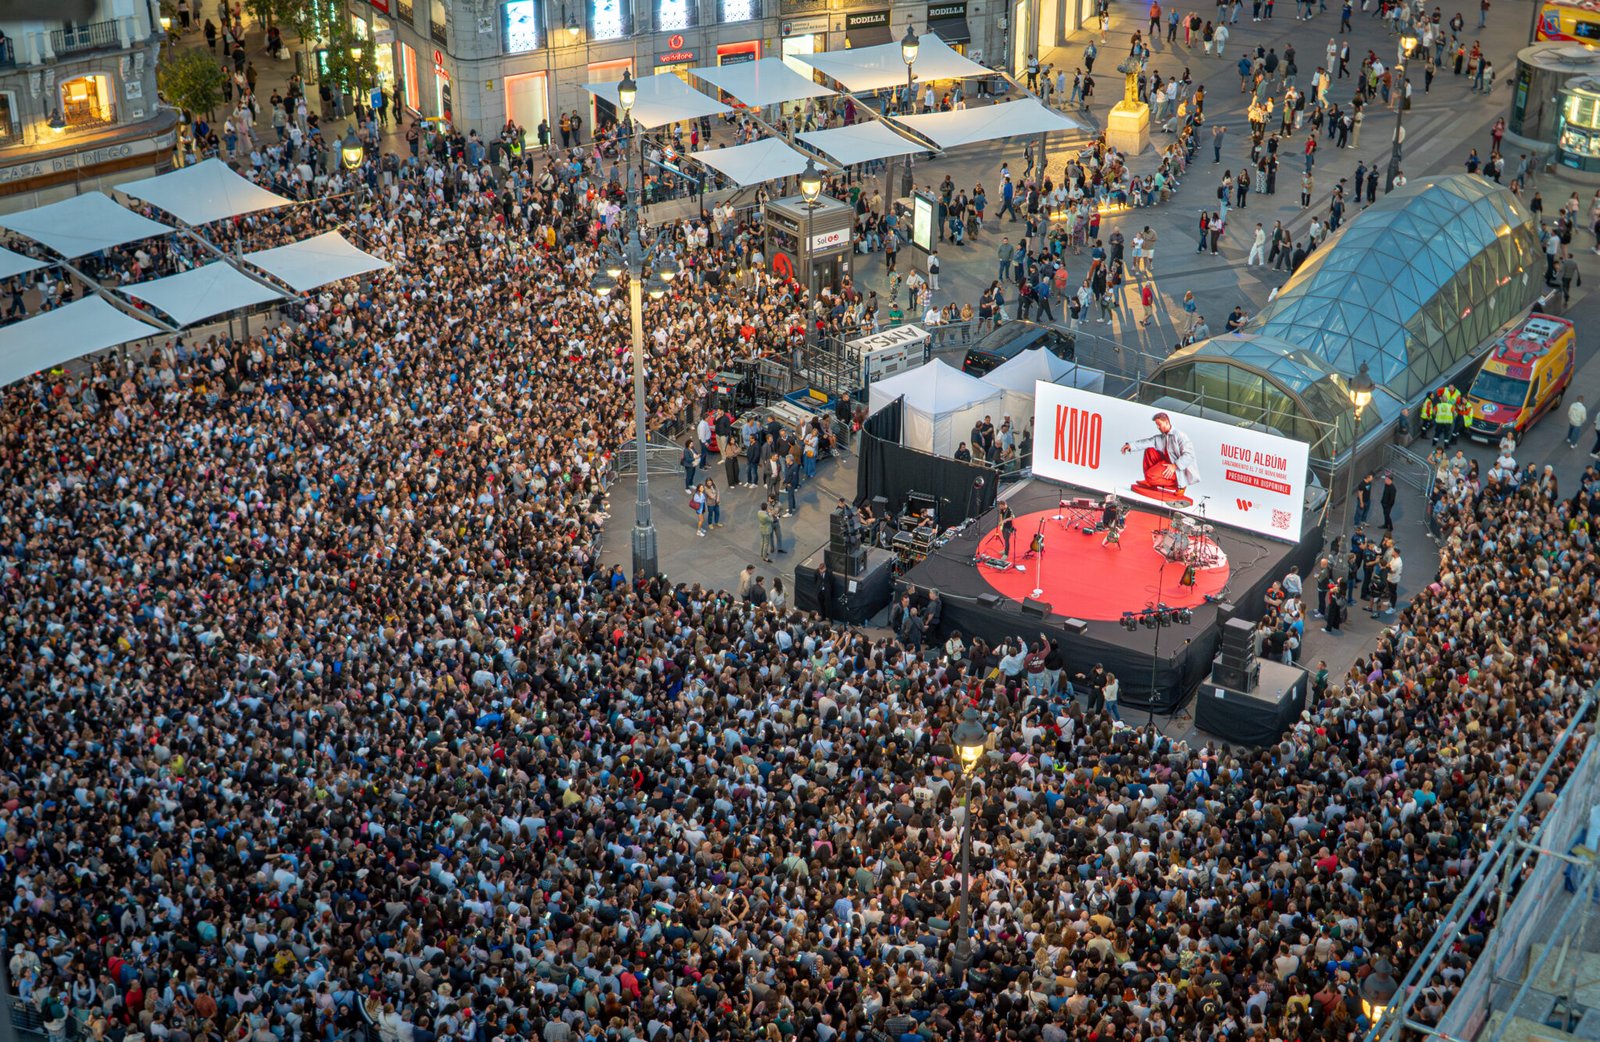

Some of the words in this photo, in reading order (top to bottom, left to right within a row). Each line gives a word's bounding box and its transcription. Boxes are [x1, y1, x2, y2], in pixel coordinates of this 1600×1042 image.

[850, 15, 885, 24] RODILLA
[929, 7, 964, 16] RODILLA
[660, 51, 694, 63] vodafone
[0, 162, 42, 181] CASA
[52, 158, 75, 171] DE
[82, 144, 132, 166] DIEGO
[816, 236, 827, 246] Sol
[1054, 404, 1103, 470] KMO
[1221, 443, 1252, 463] NUEVO
[1253, 451, 1287, 471] ALBÚM
[1228, 471, 1253, 485] PREORDER
[1260, 479, 1289, 493] DISPONIBLE
